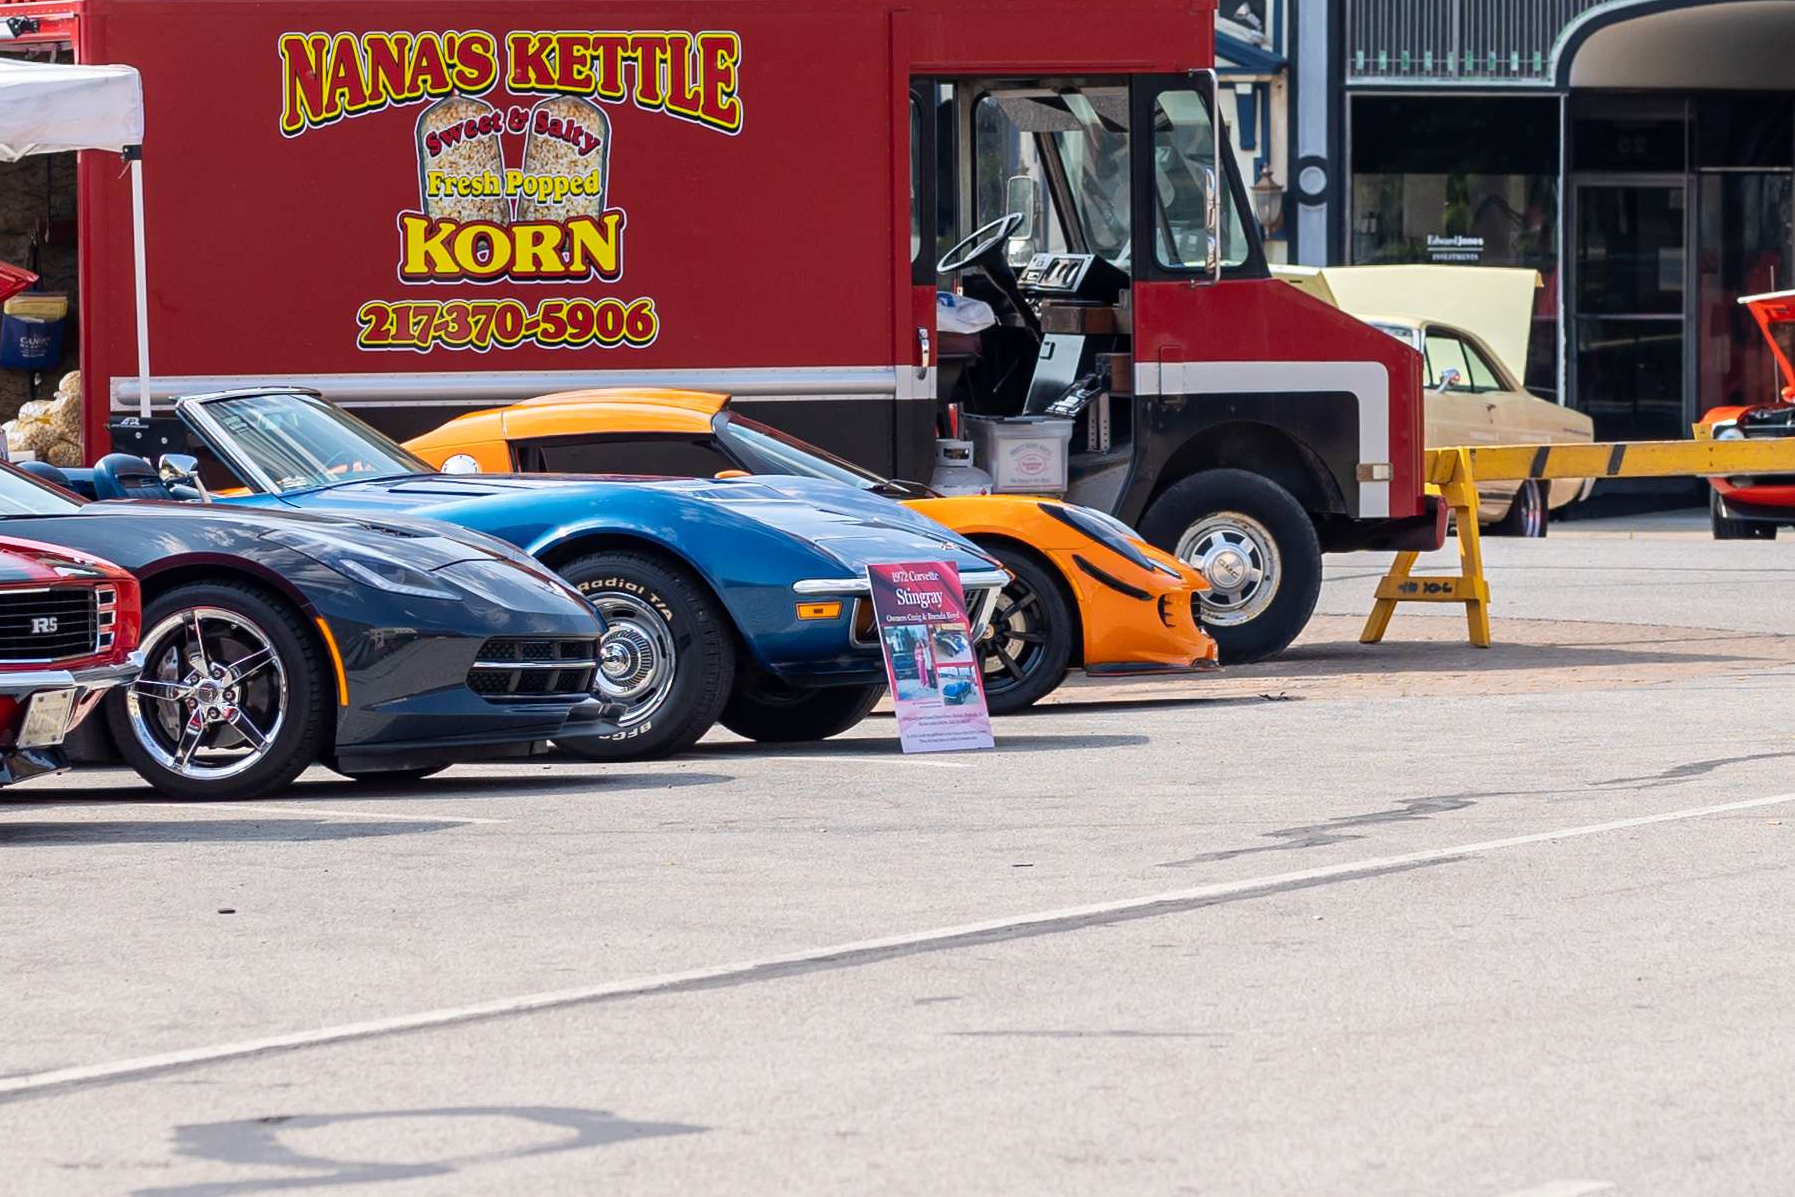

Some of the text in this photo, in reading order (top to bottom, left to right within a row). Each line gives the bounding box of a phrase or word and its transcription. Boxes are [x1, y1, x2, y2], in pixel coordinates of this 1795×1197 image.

[279, 31, 742, 138] NANA'S KETTLE
[425, 109, 504, 158] Sweet
[533, 110, 602, 156] Salty
[427, 169, 602, 204] Fresh Popped
[400, 209, 626, 282] KORN
[357, 297, 660, 352] 217-370-5906
[909, 570, 939, 582] Corvette
[1216, 558, 1240, 580] GMC
[577, 577, 674, 623] Radial T/A
[896, 588, 943, 609] Stingray
[31, 617, 58, 634] RS
